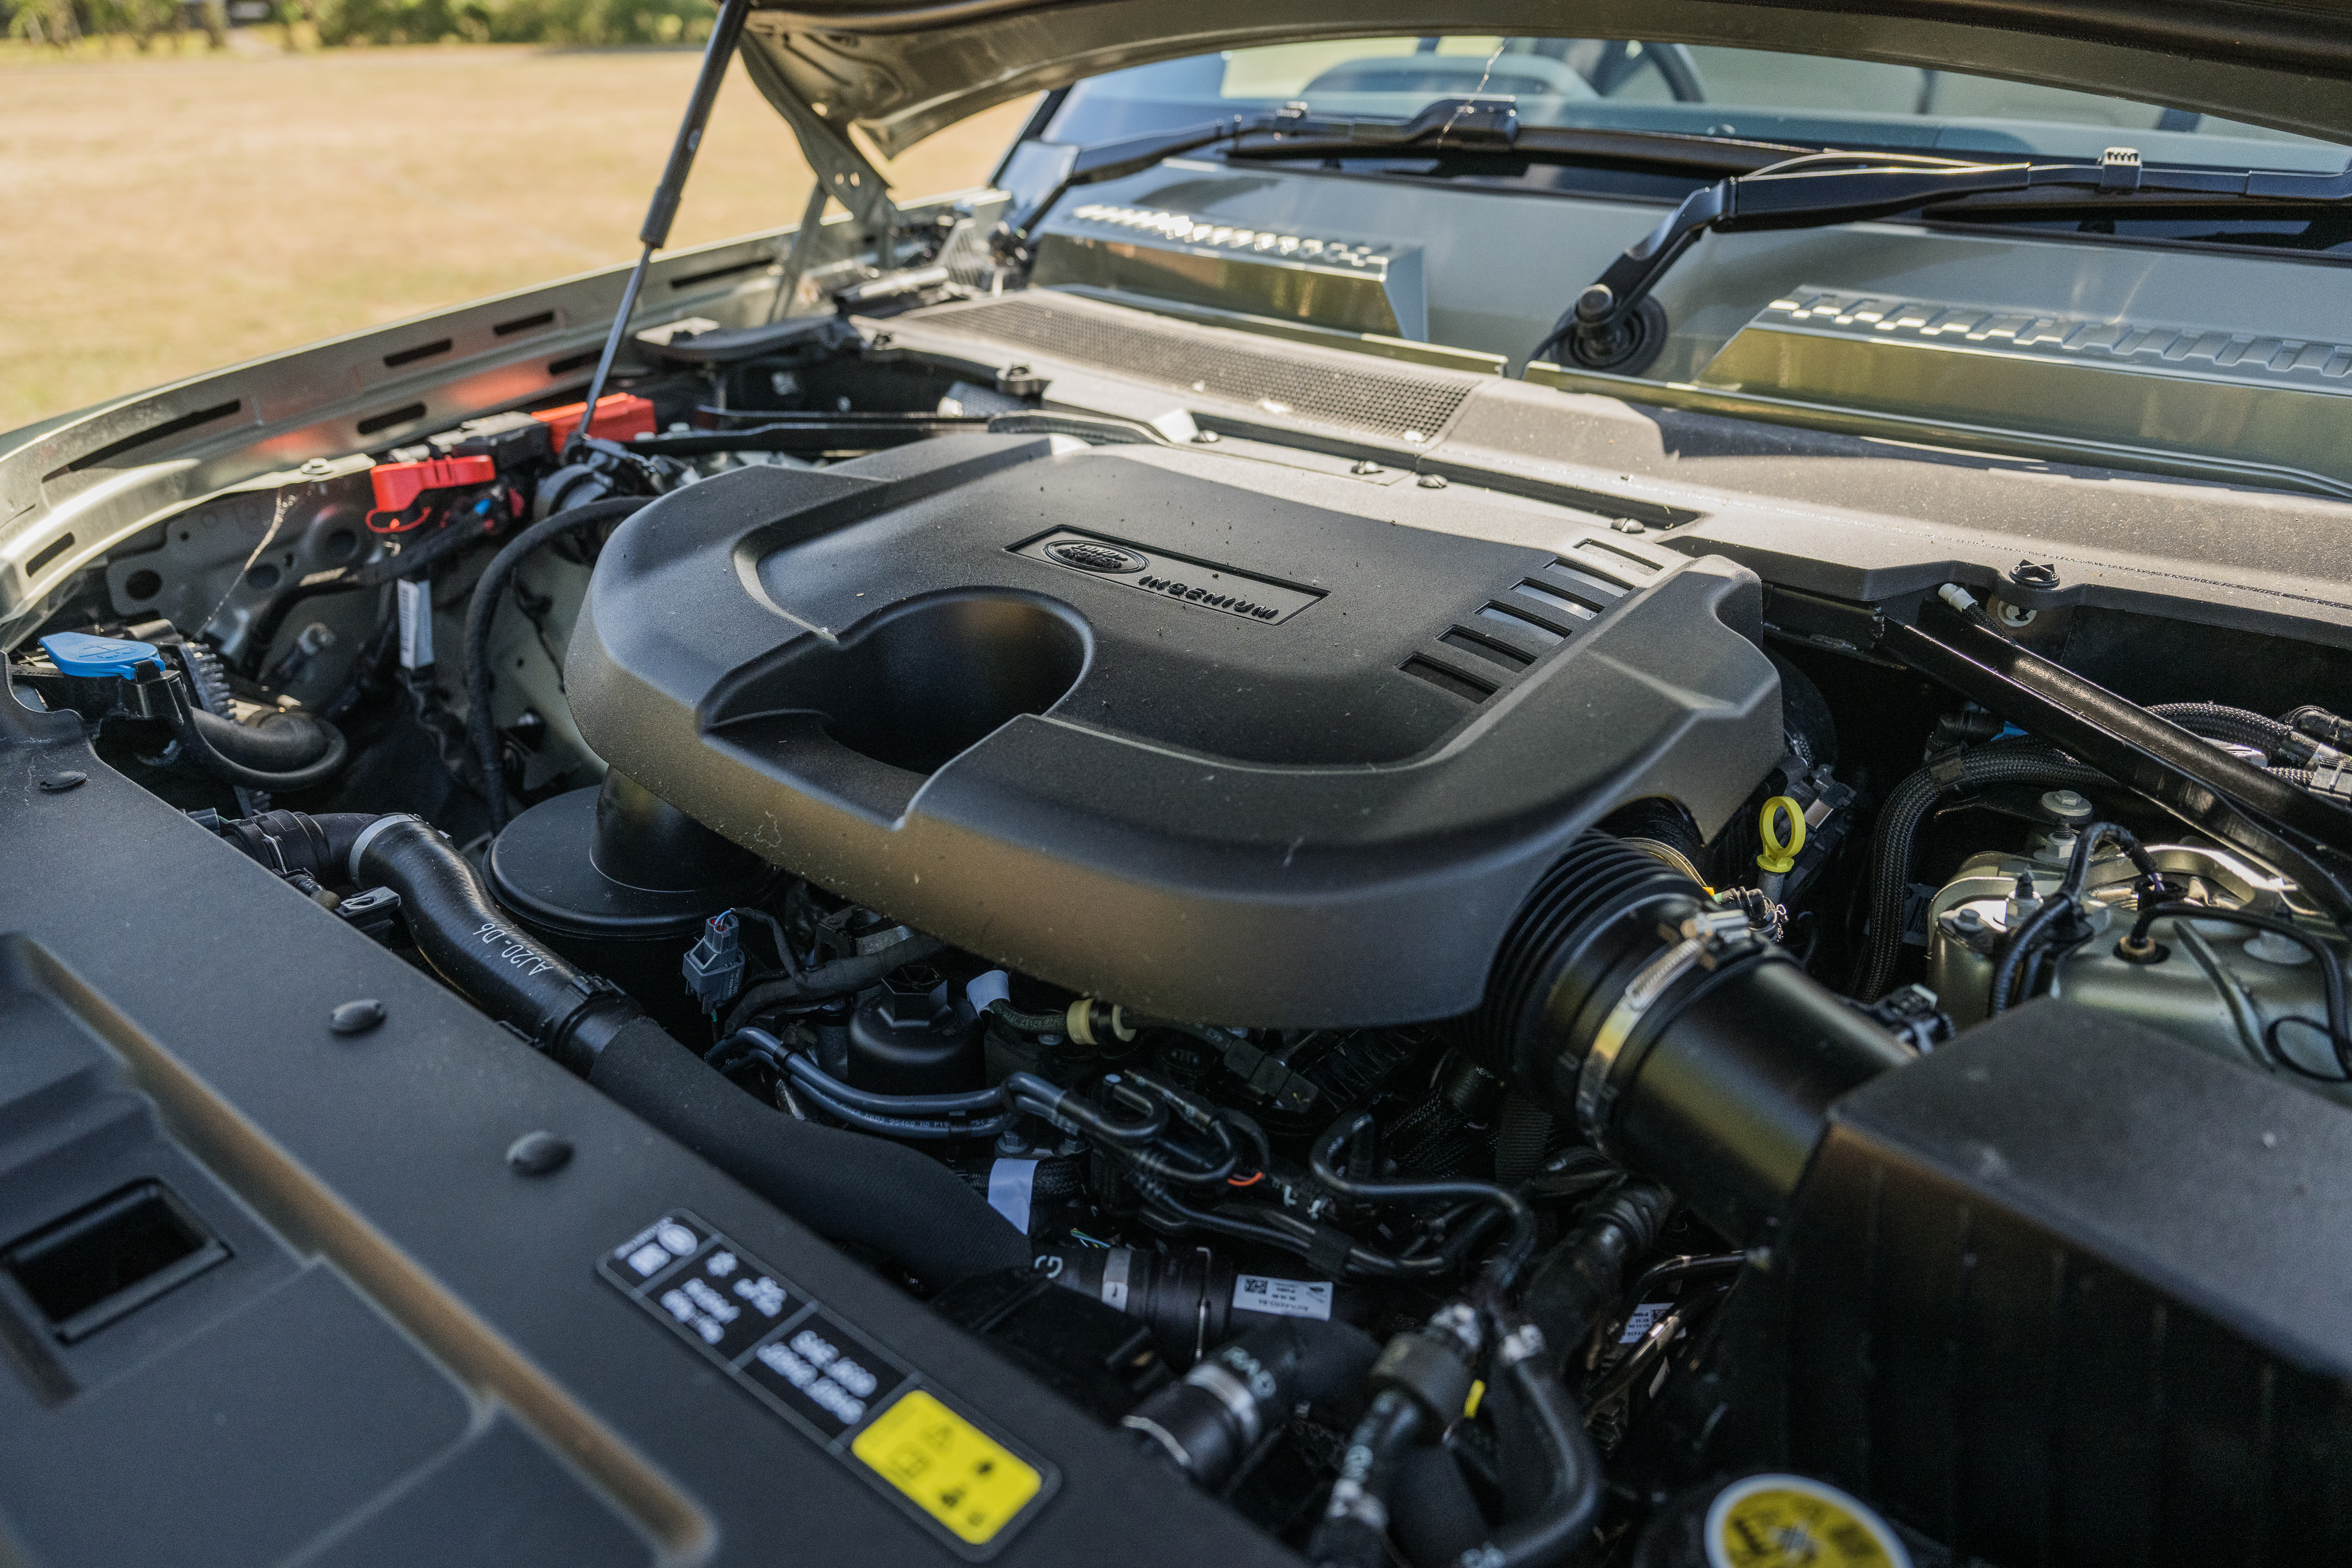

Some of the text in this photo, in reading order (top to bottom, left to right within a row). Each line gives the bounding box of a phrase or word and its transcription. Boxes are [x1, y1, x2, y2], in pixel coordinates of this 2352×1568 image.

[1063, 549, 1122, 568] ROVER
[1071, 544, 1120, 558] LAND
[1138, 575, 1279, 619] INGENIUM
